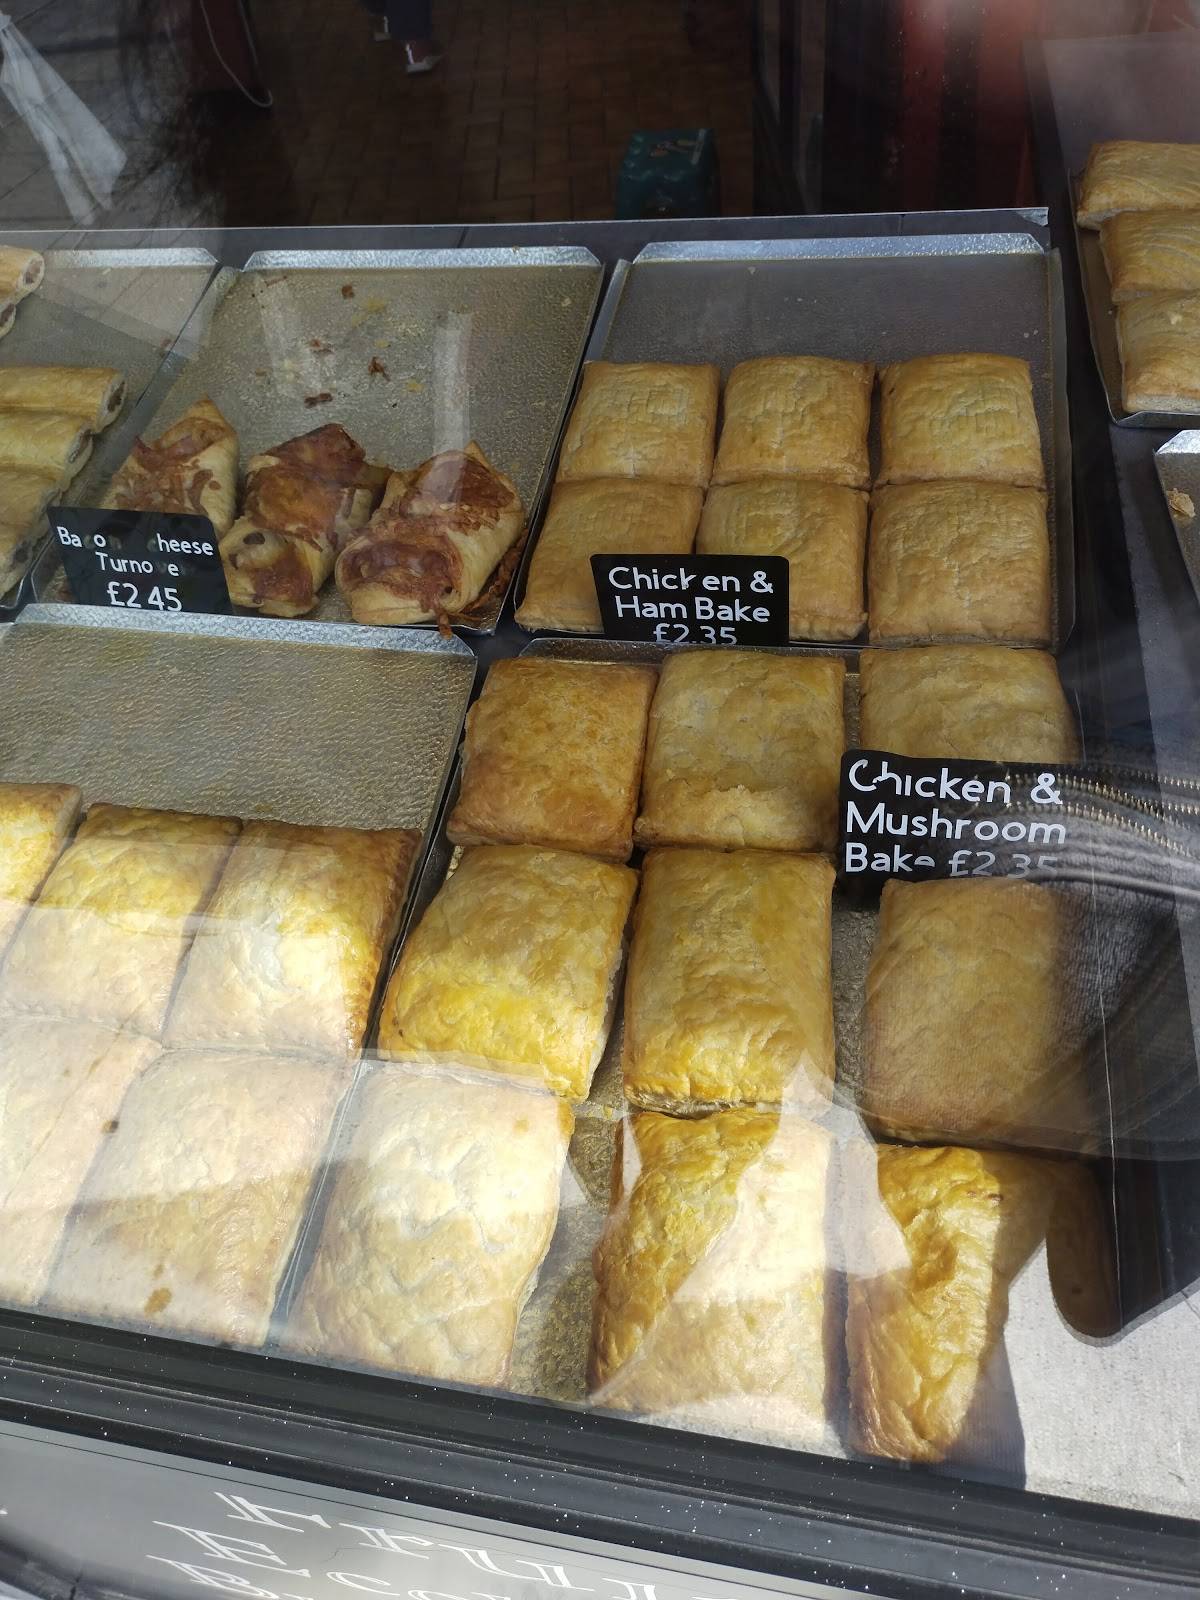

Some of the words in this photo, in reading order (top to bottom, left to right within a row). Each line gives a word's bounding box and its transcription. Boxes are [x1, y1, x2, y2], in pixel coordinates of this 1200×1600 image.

[95, 551, 186, 577] Turnoe
[608, 566, 741, 592] Chicken
[750, 570, 774, 593] &
[615, 595, 688, 619] Ham
[694, 596, 771, 622] Bake
[848, 758, 1011, 804] Chicken
[1030, 772, 1063, 805] &
[846, 800, 1066, 844] Mushroom
